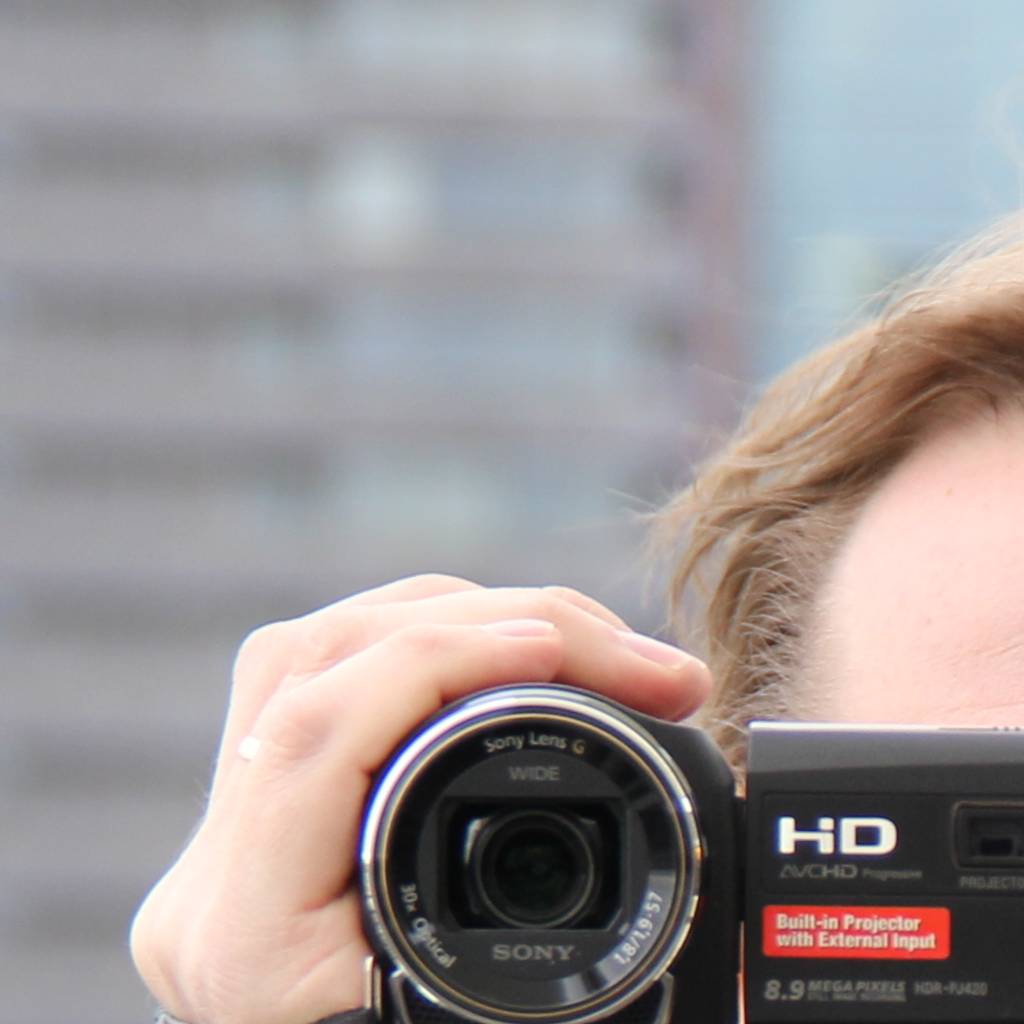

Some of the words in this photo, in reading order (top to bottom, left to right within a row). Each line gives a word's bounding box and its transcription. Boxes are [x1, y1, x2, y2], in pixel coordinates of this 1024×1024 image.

[485, 735, 524, 753] Sony
[529, 731, 567, 748] Lens
[572, 739, 585, 754] G
[508, 766, 560, 781] WIDE
[780, 865, 858, 880] AVCHD
[776, 914, 838, 929] Built-in
[844, 915, 921, 933] Projector
[777, 932, 813, 946] with
[819, 933, 887, 948] External
[893, 934, 935, 951] Input
[492, 944, 574, 961] SONY
[764, 979, 805, 1001] 8.9
[808, 980, 853, 993] MEGA
[855, 981, 906, 993] PIXELS
